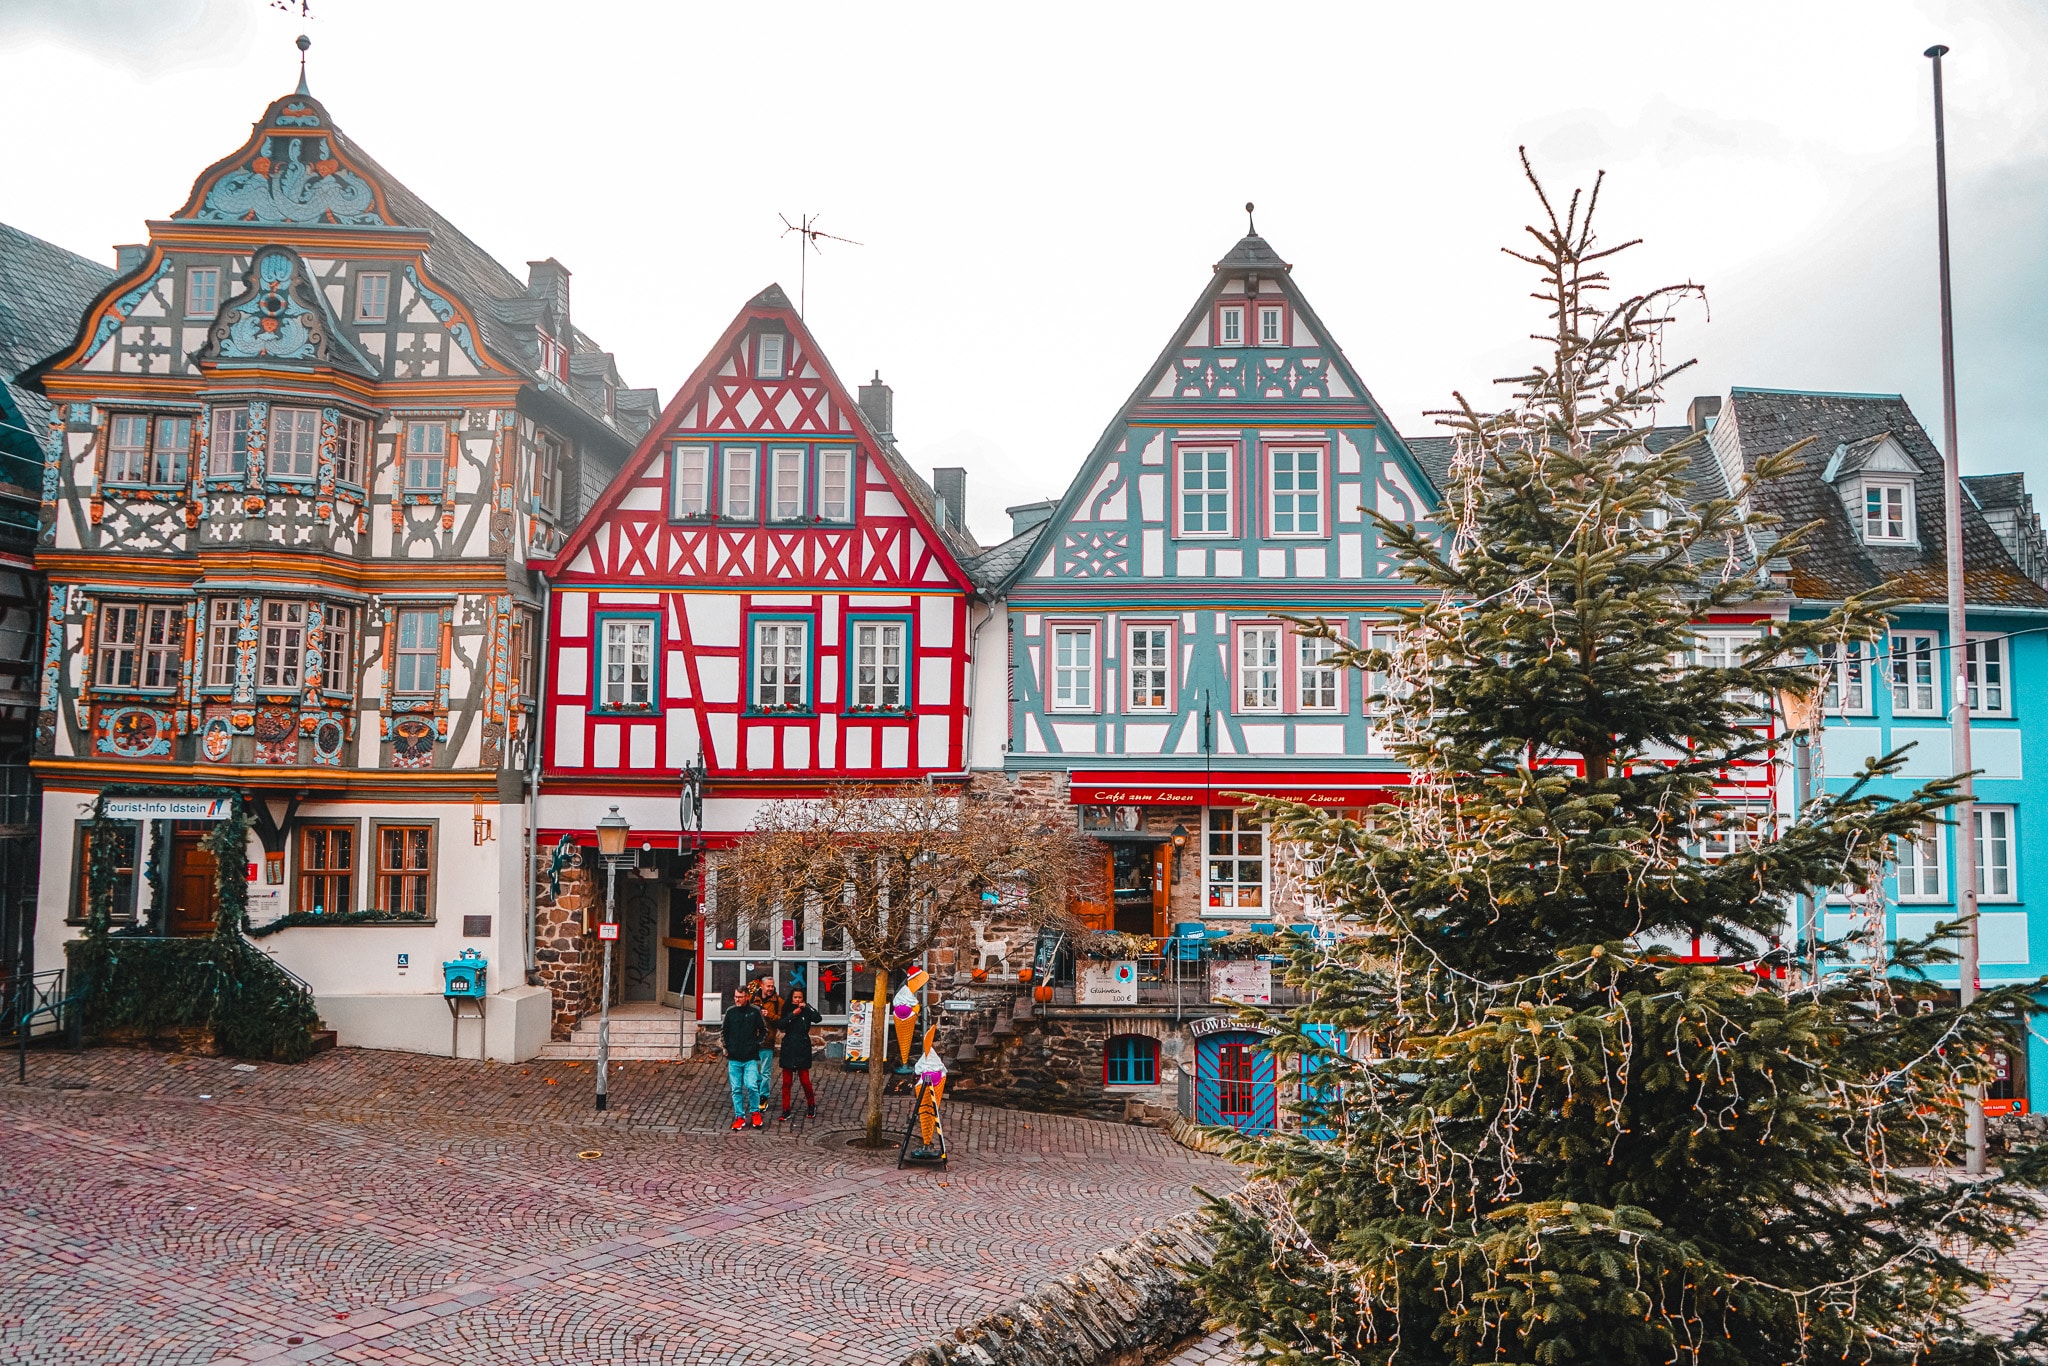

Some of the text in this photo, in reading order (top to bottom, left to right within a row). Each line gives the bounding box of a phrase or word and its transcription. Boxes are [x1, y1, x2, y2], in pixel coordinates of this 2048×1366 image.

[1094, 791, 1125, 802] Café
[1156, 792, 1194, 801] Löwen
[1307, 793, 1345, 802] Löwen
[169, 803, 206, 813] Idstein
[699, 902, 706, 914] 5
